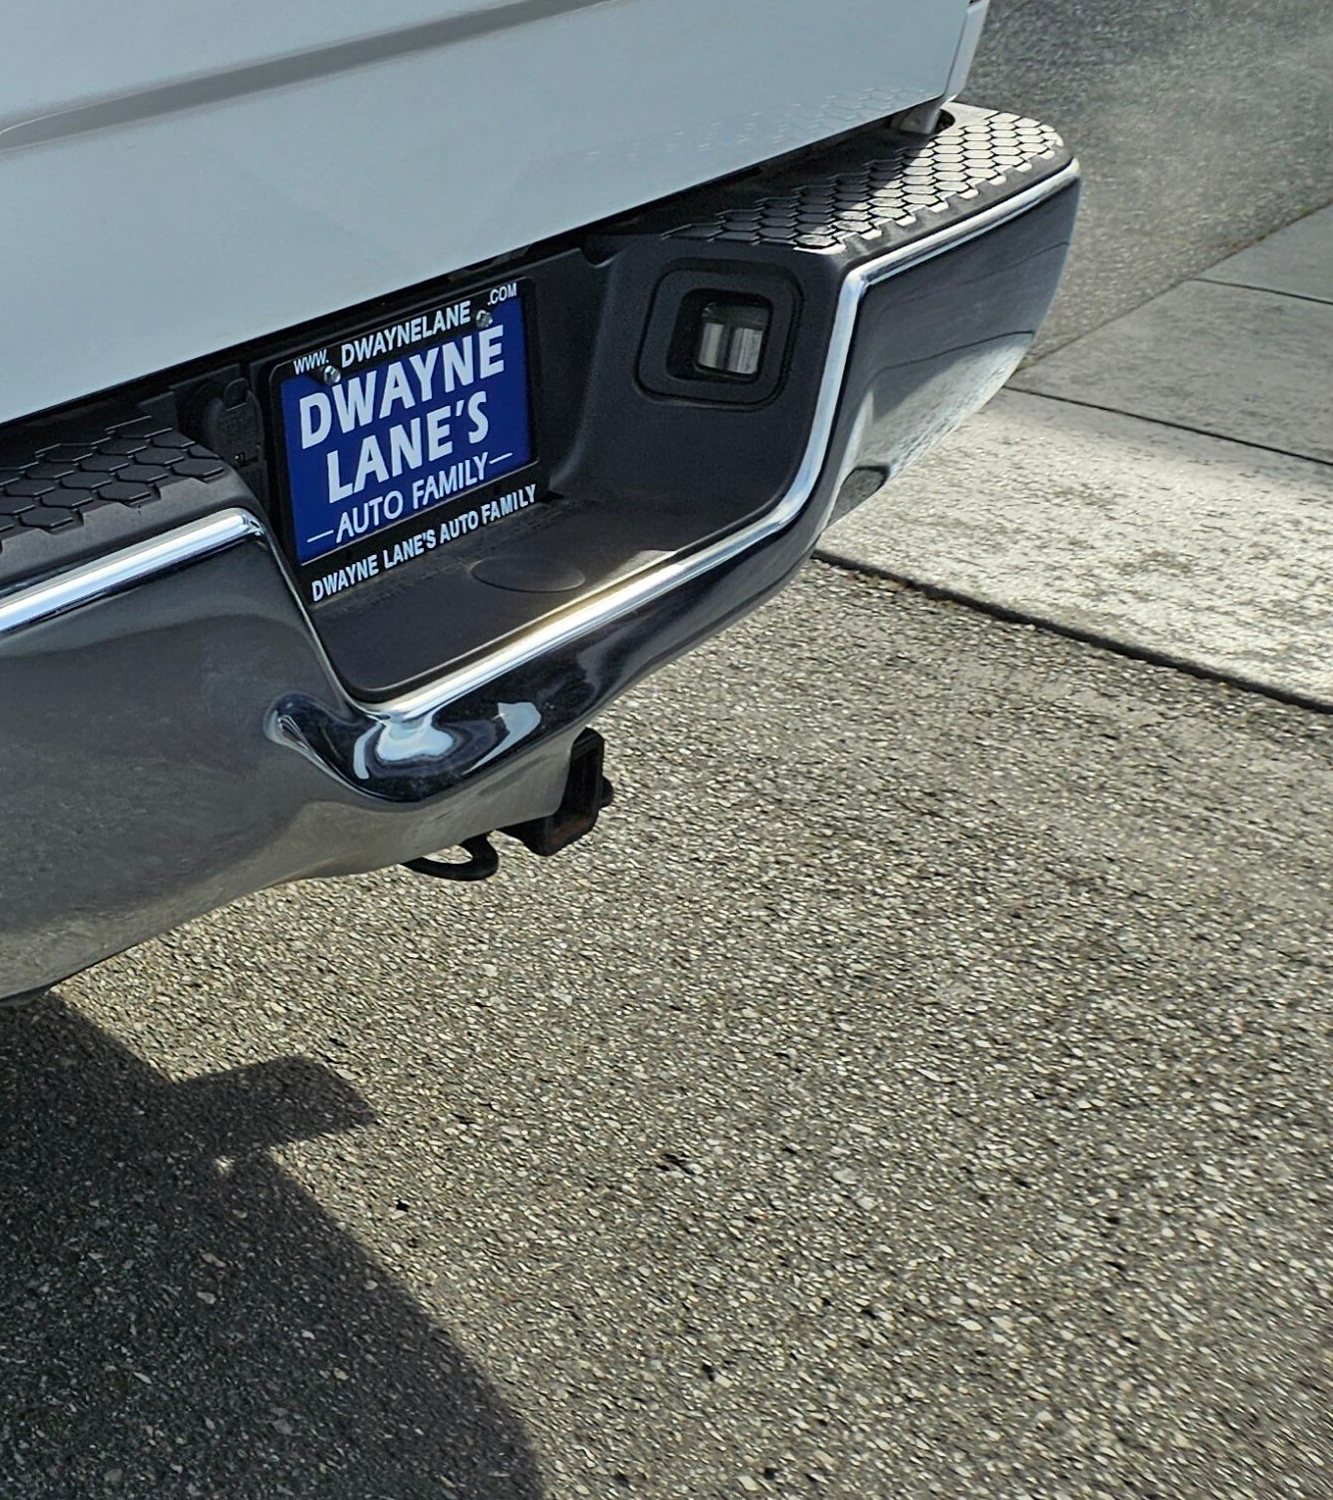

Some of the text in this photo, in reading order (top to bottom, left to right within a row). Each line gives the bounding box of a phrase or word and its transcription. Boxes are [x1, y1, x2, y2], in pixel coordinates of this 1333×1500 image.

[294, 282, 518, 376] WWW. DWAYNELANE .COM
[299, 324, 505, 450] DWAYNE
[327, 391, 489, 504] LANE'S
[336, 452, 490, 544] AUTO FAMILY
[311, 484, 537, 602] DWAYNE LANE'S AUTO FAMILY
